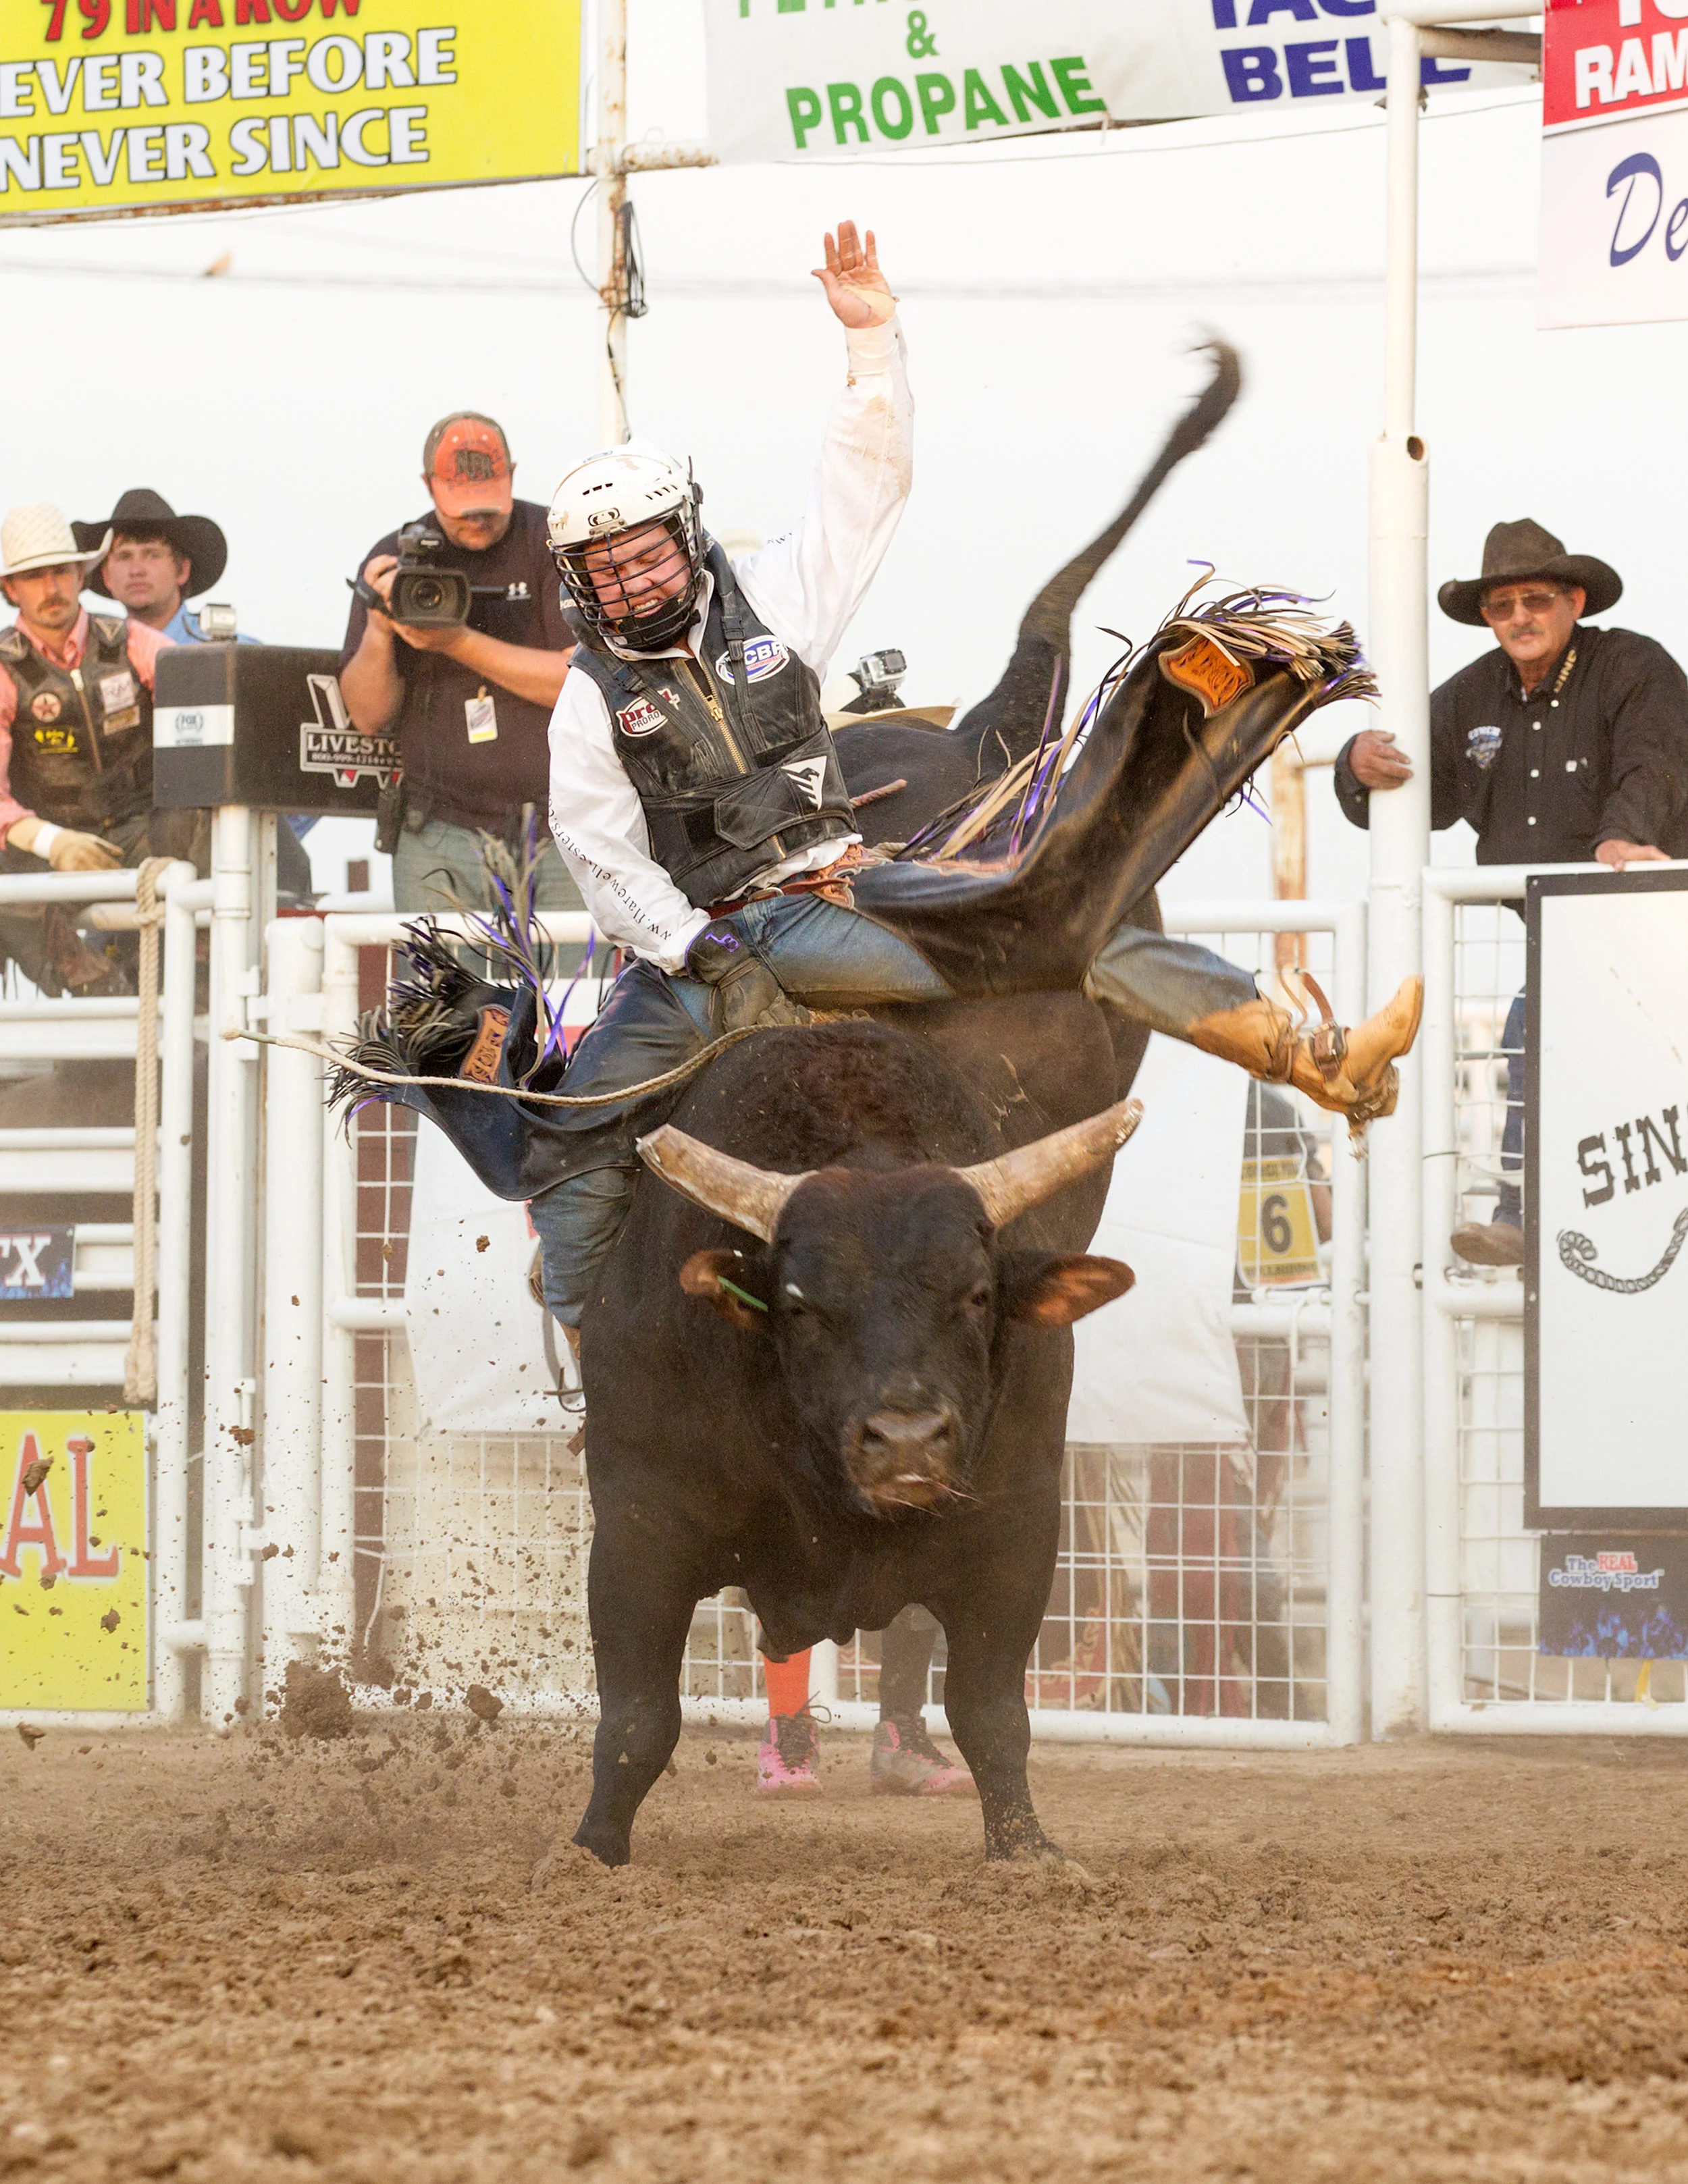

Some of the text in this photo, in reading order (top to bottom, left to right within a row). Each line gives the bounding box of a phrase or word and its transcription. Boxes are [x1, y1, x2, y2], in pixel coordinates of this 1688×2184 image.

[0, 26, 458, 118] EVER BEFORE
[905, 9, 940, 59] &
[1574, 27, 1688, 109] RAM
[785, 55, 1109, 149] PROPANE
[0, 105, 430, 193] NEVER SINCE
[1606, 152, 1688, 267] De
[1577, 1104, 1688, 1209] SIN
[0, 1235, 52, 1287] X
[1261, 1193, 1292, 1254] 6
[1550, 1571, 1657, 1590] Cowboy Sport
[1567, 1554, 1636, 1571] The REAL
